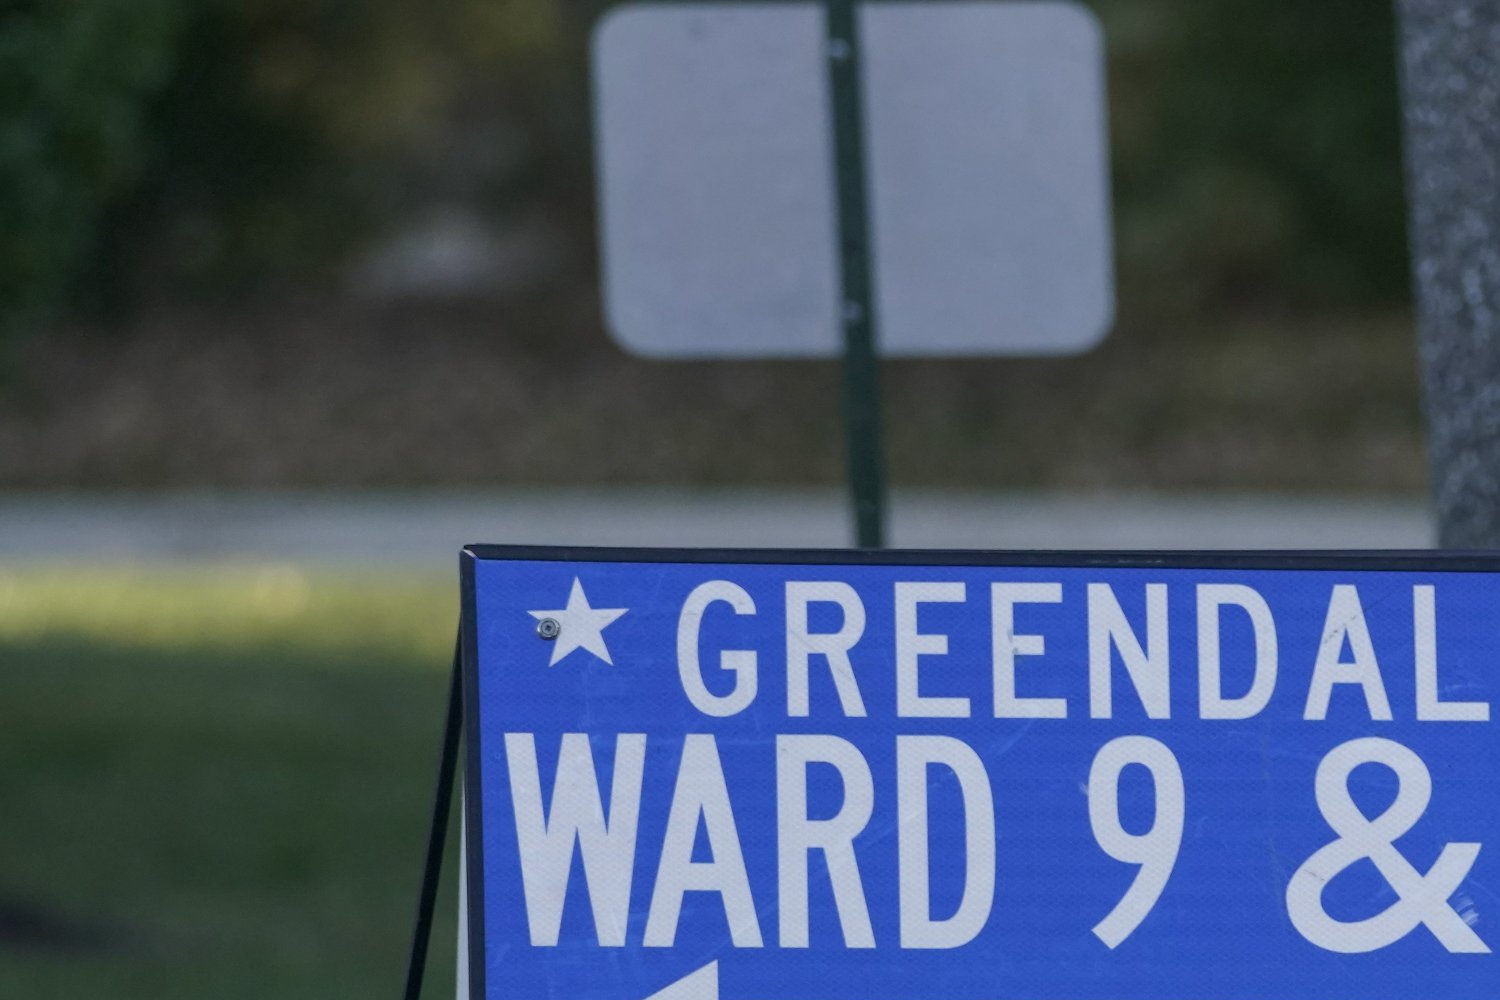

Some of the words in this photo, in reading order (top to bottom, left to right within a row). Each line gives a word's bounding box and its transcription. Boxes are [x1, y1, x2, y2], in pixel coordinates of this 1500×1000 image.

[503, 732, 998, 949] WARD
[1086, 735, 1187, 950] 9
[1285, 737, 1493, 954] &
